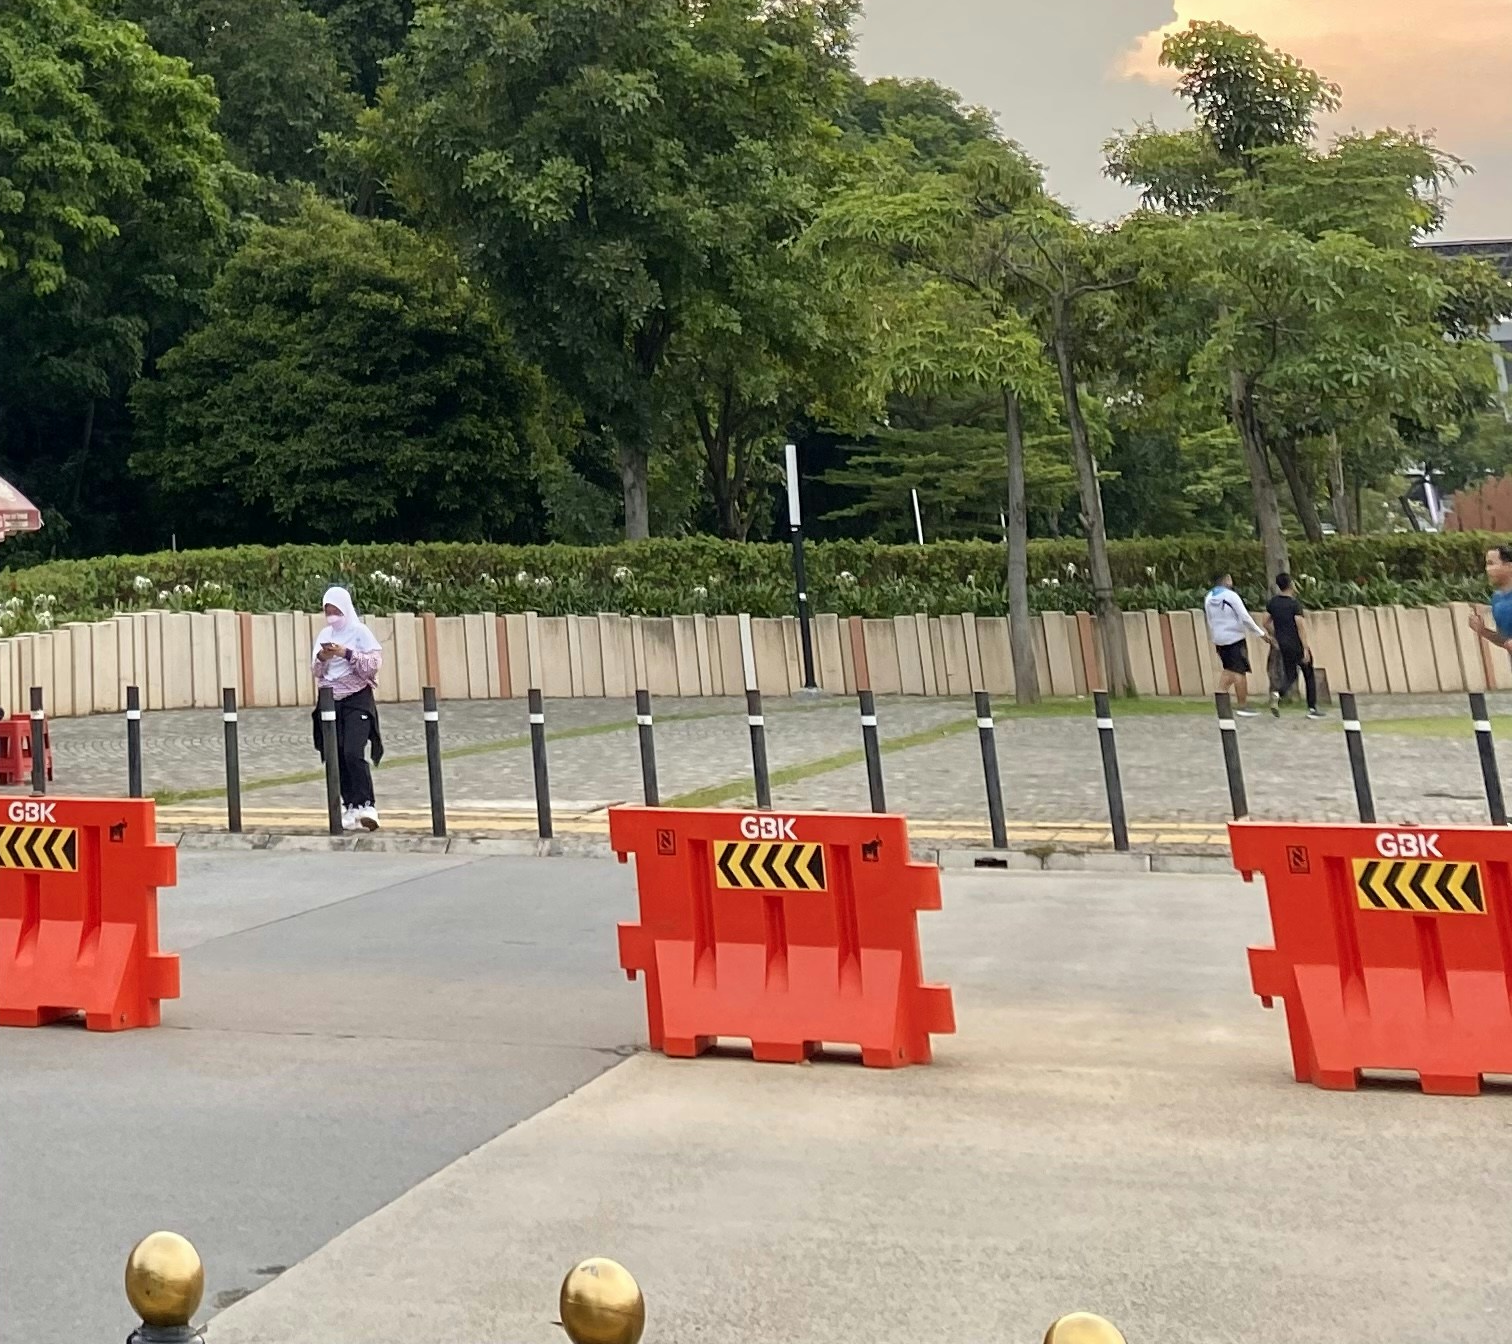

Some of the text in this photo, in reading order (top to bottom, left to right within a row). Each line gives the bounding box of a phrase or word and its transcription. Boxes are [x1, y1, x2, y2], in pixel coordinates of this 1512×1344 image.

[8, 801, 57, 823] GBK
[740, 816, 798, 840] GBK
[1375, 832, 1443, 858] GBK
